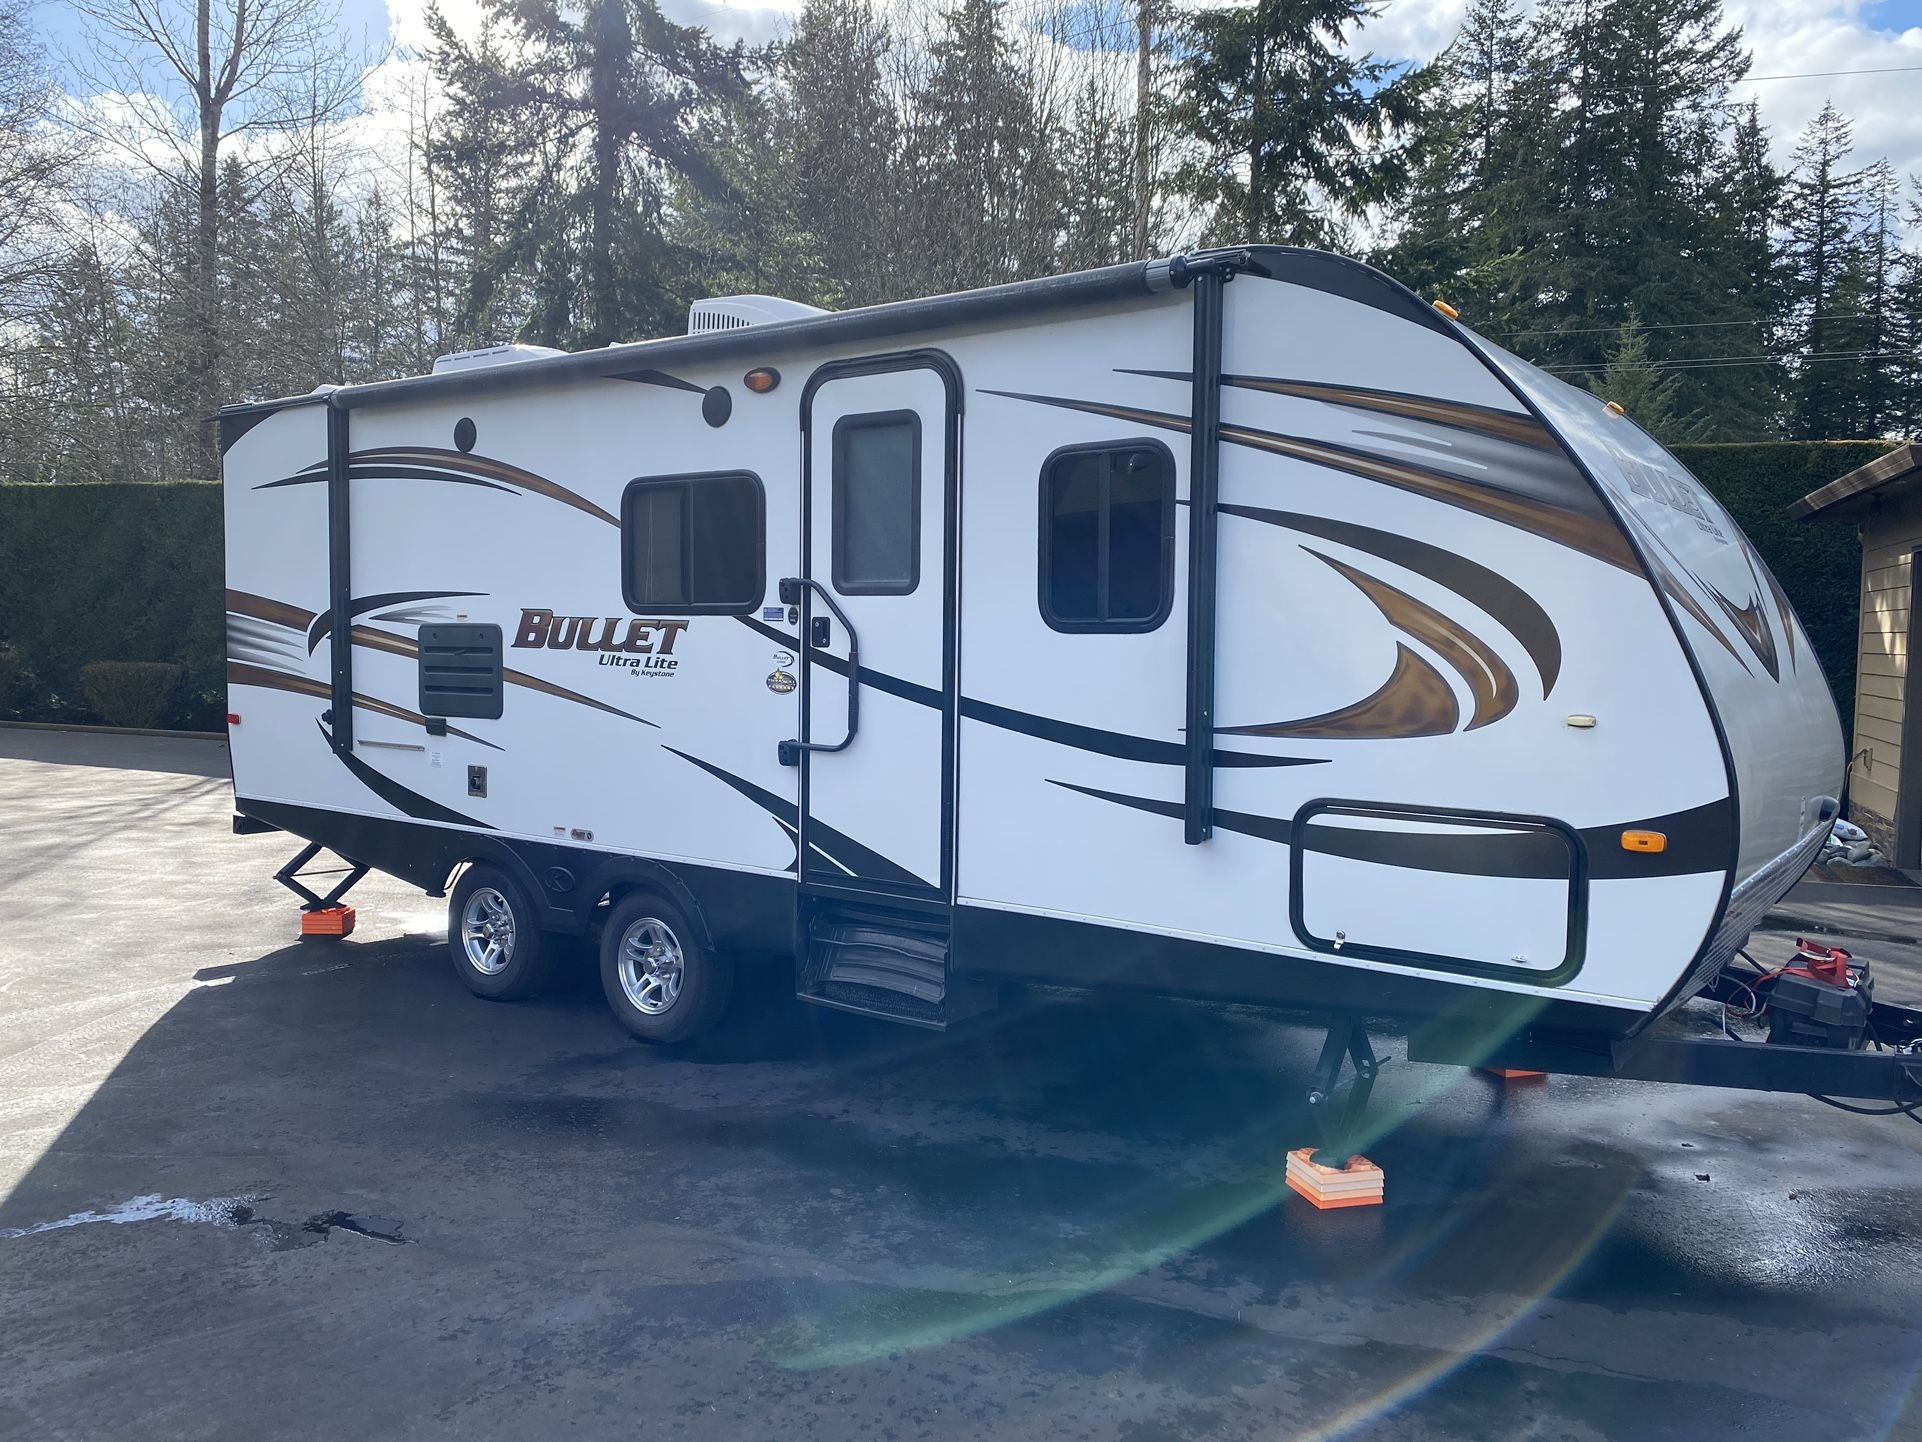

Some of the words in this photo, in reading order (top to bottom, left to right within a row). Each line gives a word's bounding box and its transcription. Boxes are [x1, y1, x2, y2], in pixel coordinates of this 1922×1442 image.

[511, 608, 689, 654] BULLET
[598, 654, 640, 667] Ultra
[644, 656, 679, 669] Lite
[630, 669, 640, 677] By
[641, 669, 675, 677] Keystone
